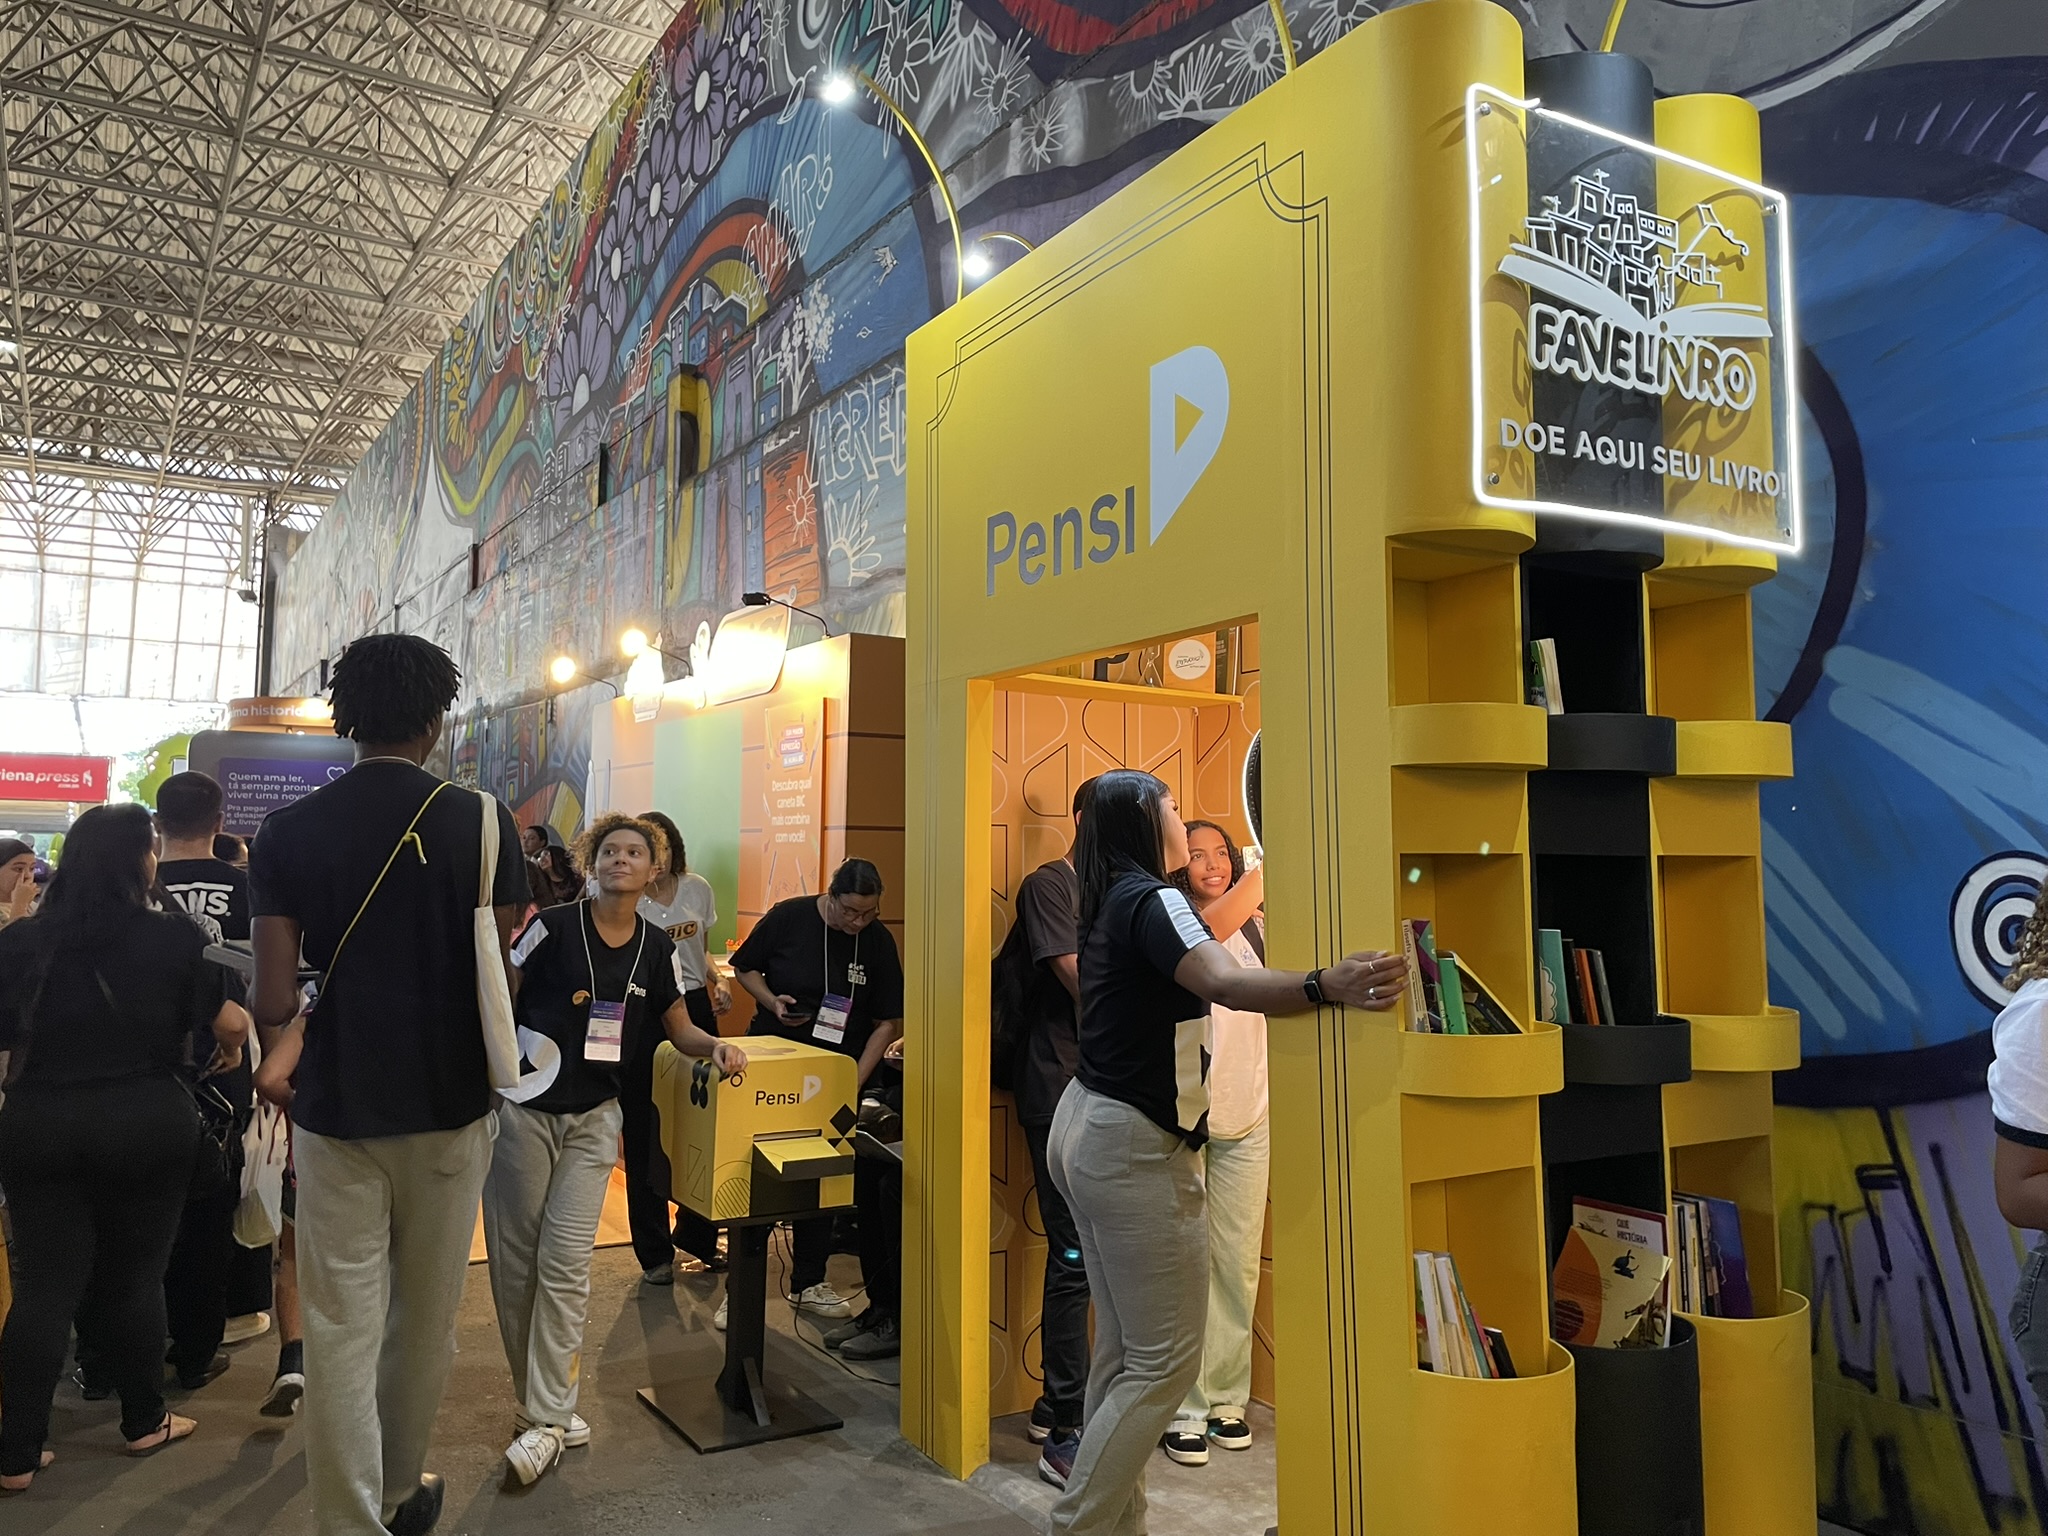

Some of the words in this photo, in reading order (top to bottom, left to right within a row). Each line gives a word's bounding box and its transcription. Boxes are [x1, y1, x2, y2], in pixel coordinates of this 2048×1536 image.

[1529, 302, 1757, 411] FAVELIVRO
[1500, 418, 1566, 455] DOE
[1573, 431, 1645, 470] AQUI
[1651, 446, 1701, 481] SEU
[1708, 457, 1787, 498] LIVRO!
[228, 772, 261, 782] Quem
[289, 774, 304, 783] ler,
[228, 782, 239, 790] tá
[241, 783, 281, 792] sempre
[772, 779, 798, 792] Descubra
[799, 776, 812, 792] qual
[227, 790, 253, 799] viver
[255, 791, 279, 800] uma
[226, 804, 241, 812] Pra
[243, 804, 267, 813] pegar
